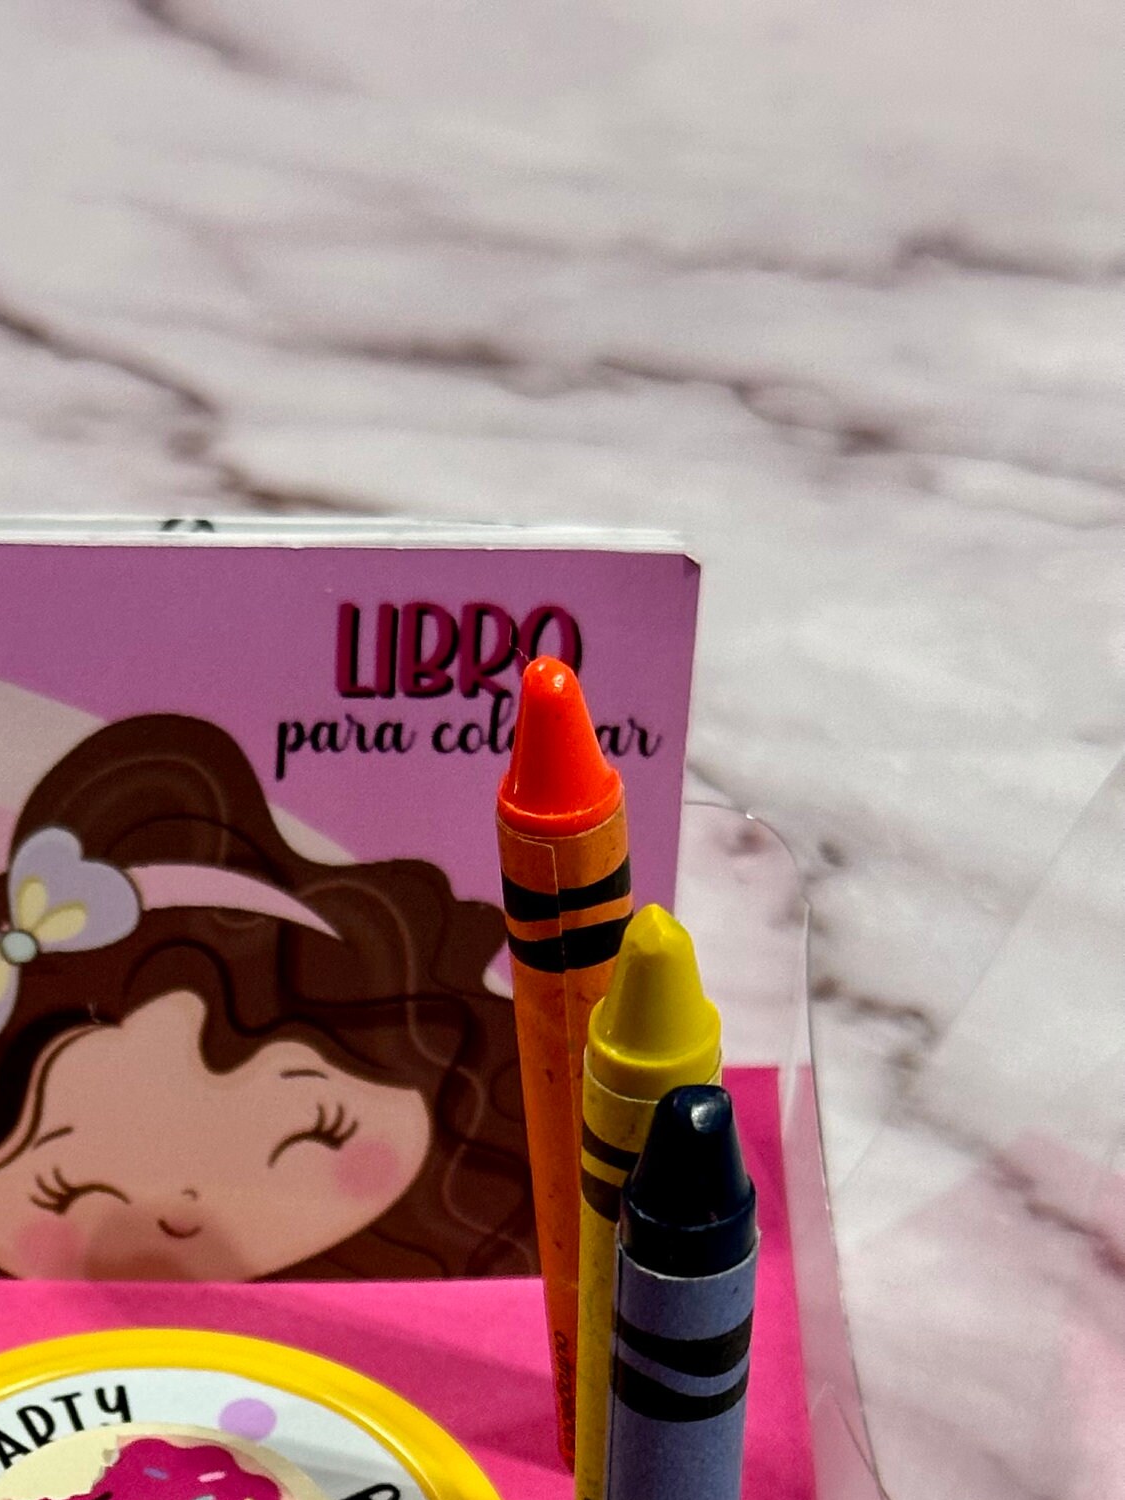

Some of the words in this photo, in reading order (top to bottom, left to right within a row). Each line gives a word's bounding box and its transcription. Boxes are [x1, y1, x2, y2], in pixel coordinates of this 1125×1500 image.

[334, 602, 583, 698] LIBRO
[275, 714, 416, 782] para
[431, 691, 662, 759] colar
